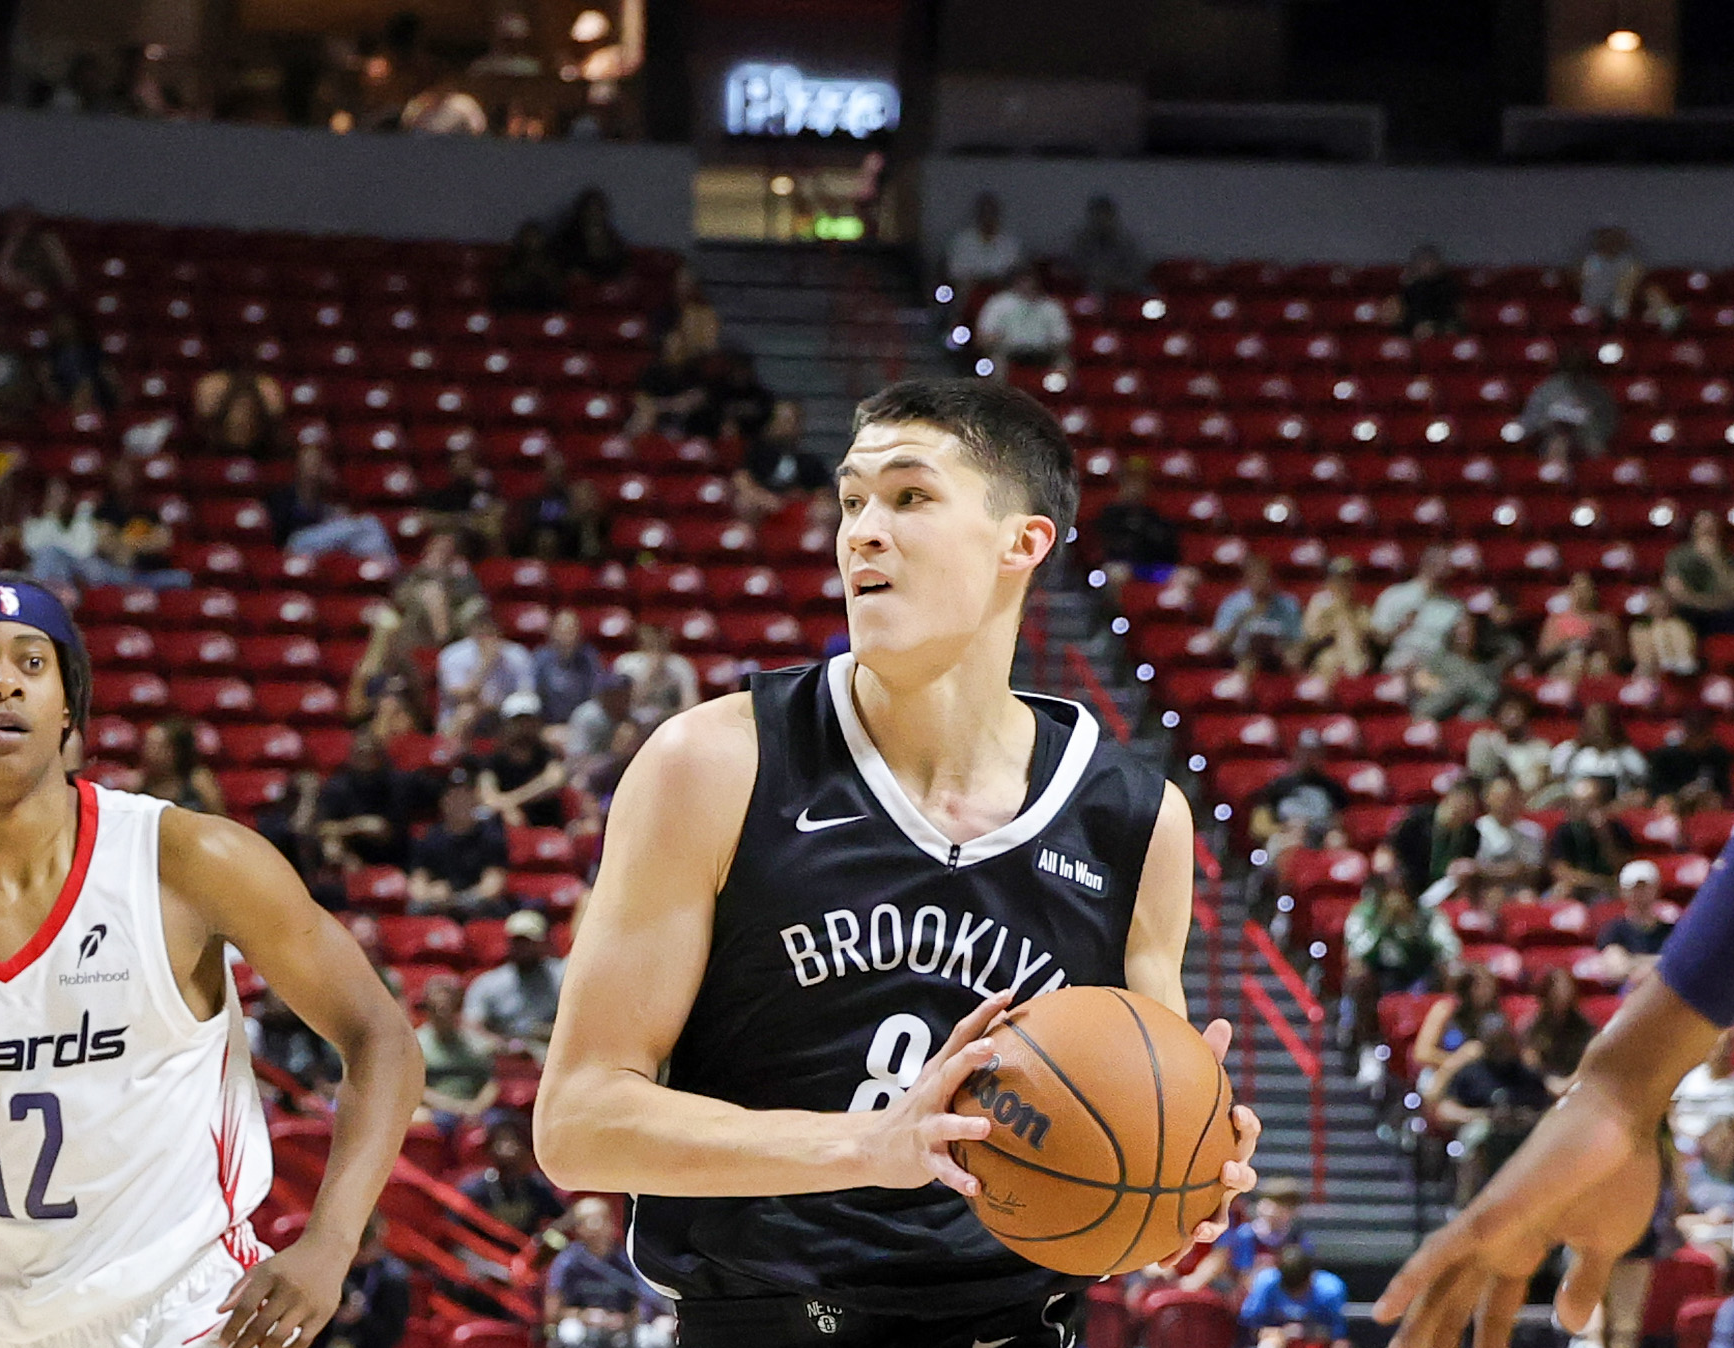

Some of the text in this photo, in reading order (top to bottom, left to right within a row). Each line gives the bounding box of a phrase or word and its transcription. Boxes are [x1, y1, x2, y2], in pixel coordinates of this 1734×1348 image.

[1037, 848, 1103, 891] All In Won
[59, 968, 130, 986] Robinhood
